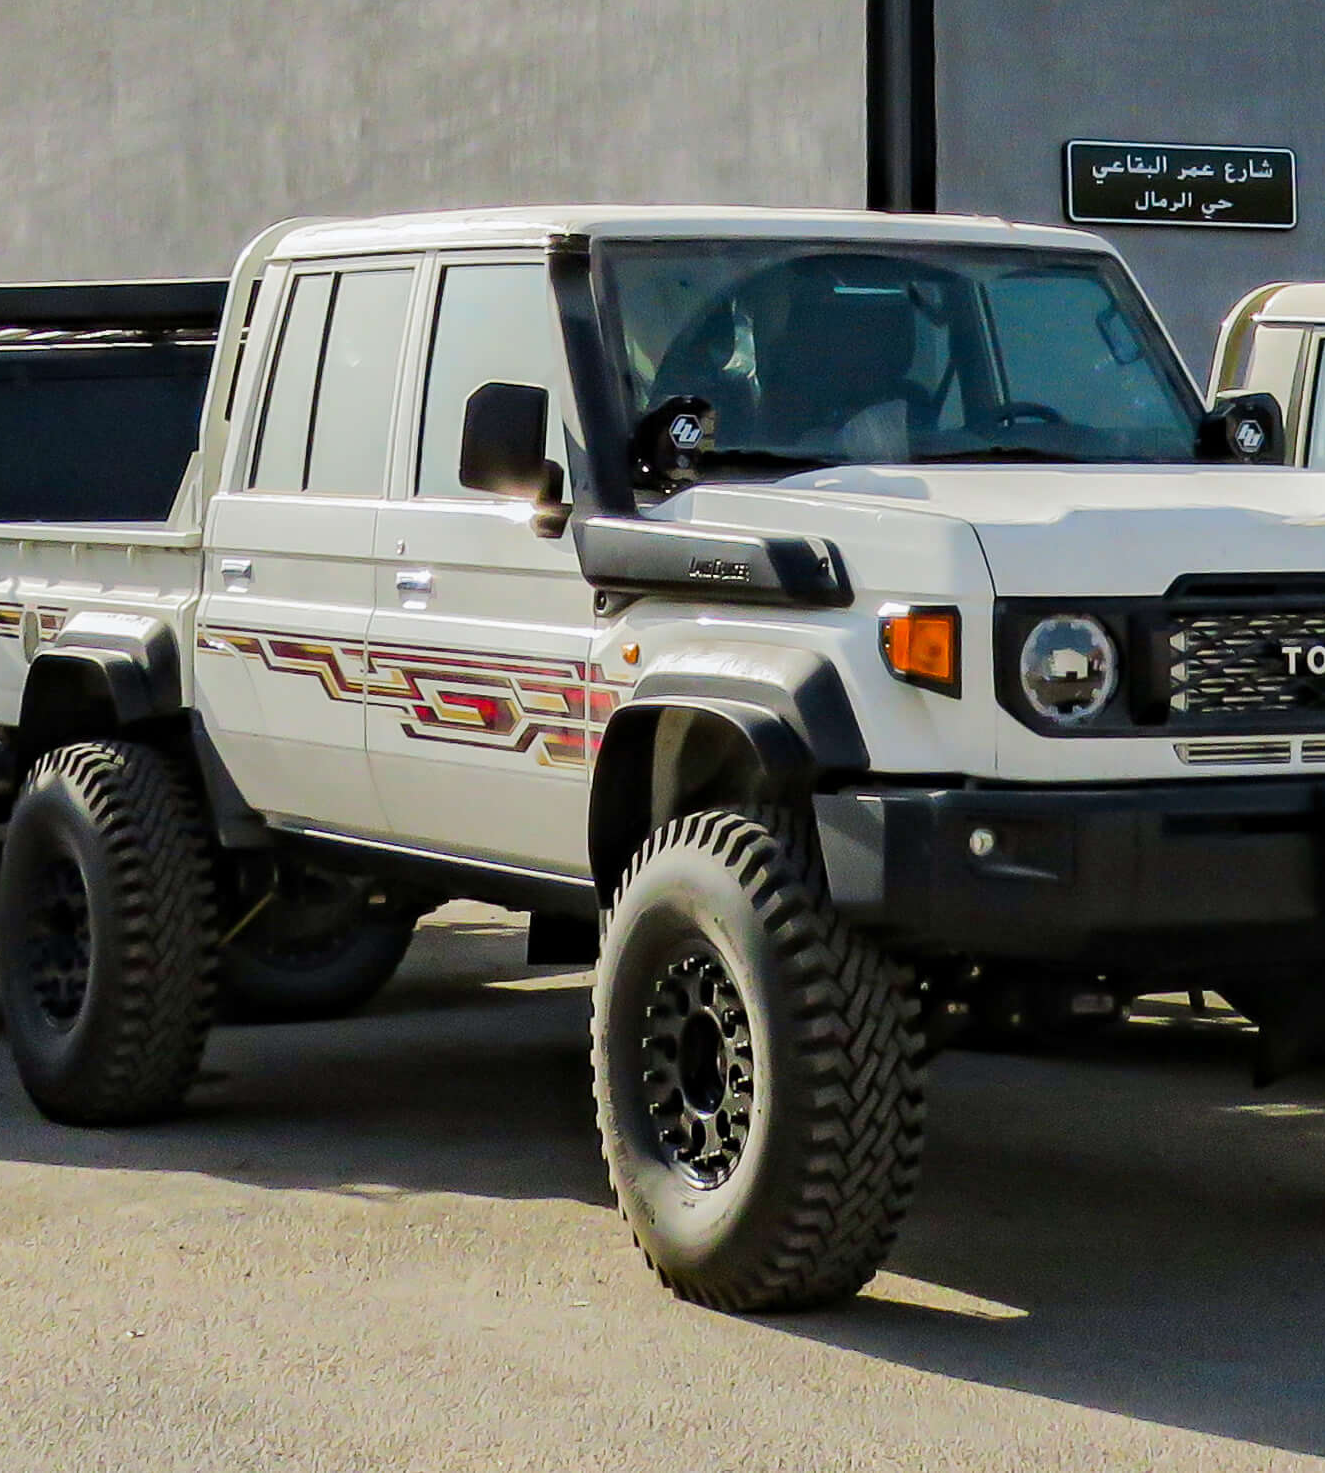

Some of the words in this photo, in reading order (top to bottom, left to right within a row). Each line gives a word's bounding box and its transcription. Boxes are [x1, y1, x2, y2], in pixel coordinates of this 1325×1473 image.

[1092, 153, 1168, 184] البقاعي
[1177, 160, 1215, 181] عمر
[1224, 158, 1274, 183] شارع
[1135, 190, 1193, 212] الرمال
[1201, 196, 1233, 219] حي
